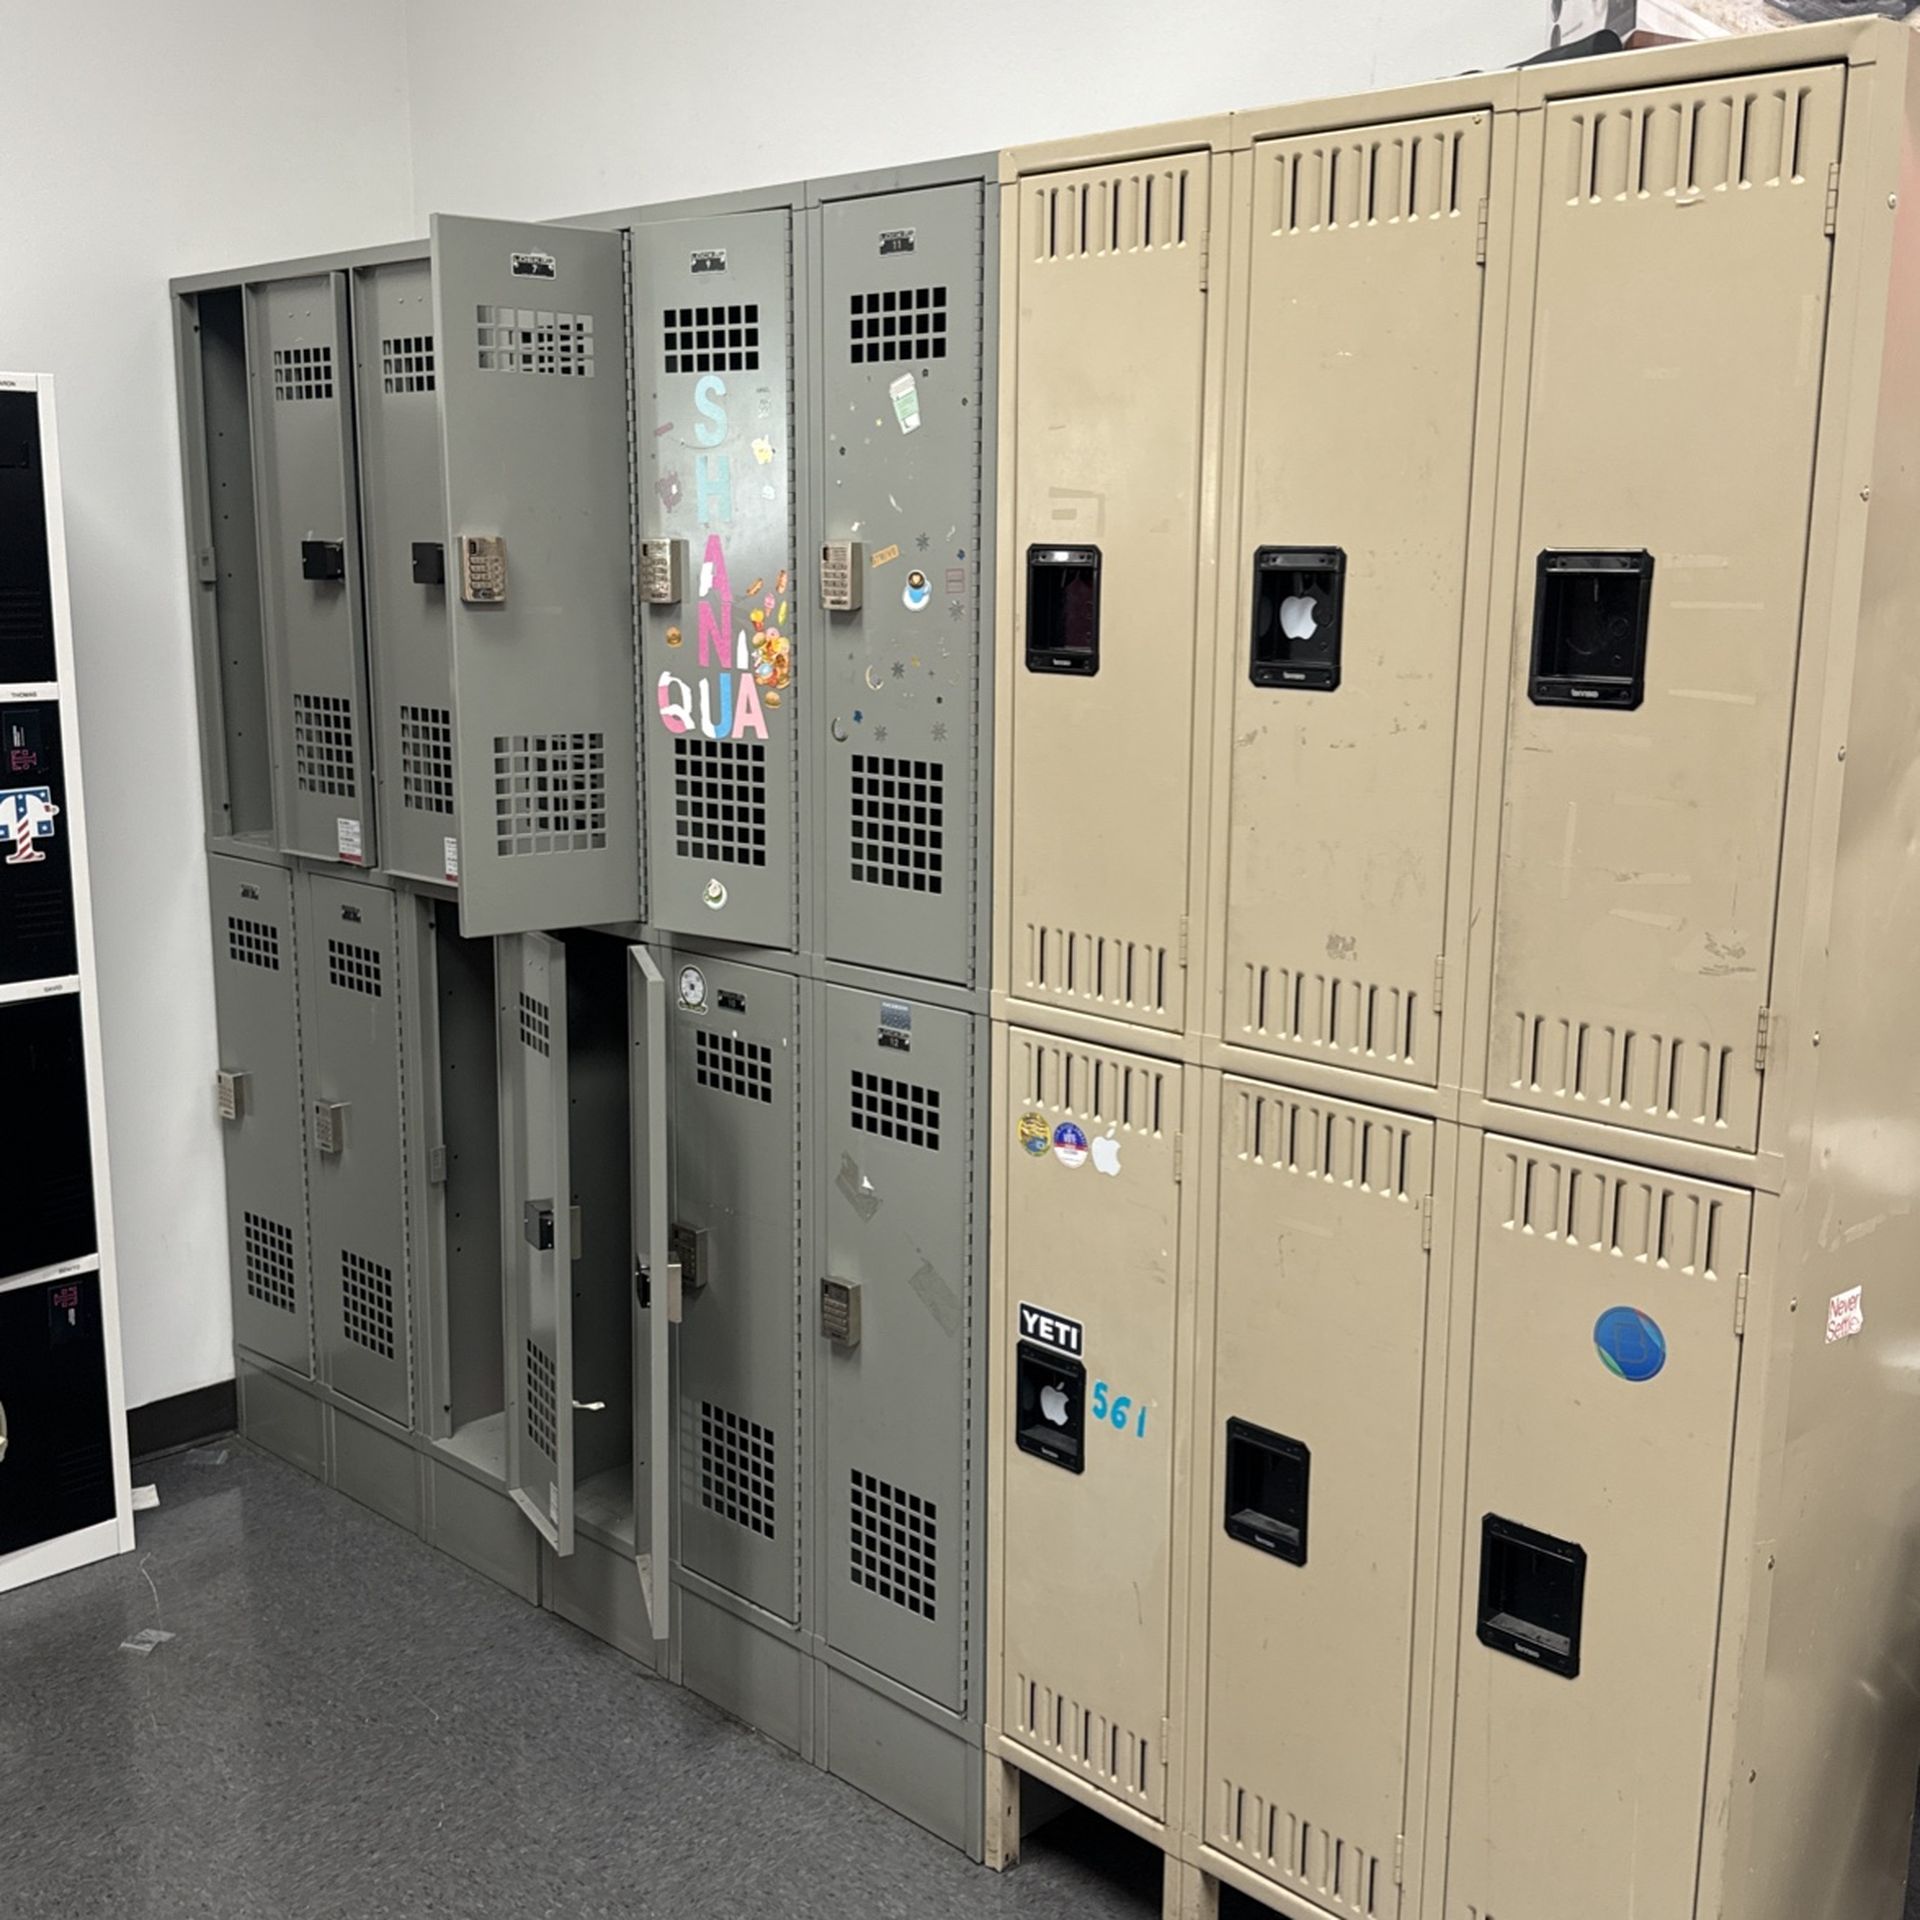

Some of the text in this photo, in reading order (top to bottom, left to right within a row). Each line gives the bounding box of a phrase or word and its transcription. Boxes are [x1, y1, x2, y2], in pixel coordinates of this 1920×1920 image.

[658, 671, 769, 739] QUA
[1023, 1309, 1078, 1350] YETI
[1093, 1381, 1146, 1438] 561
